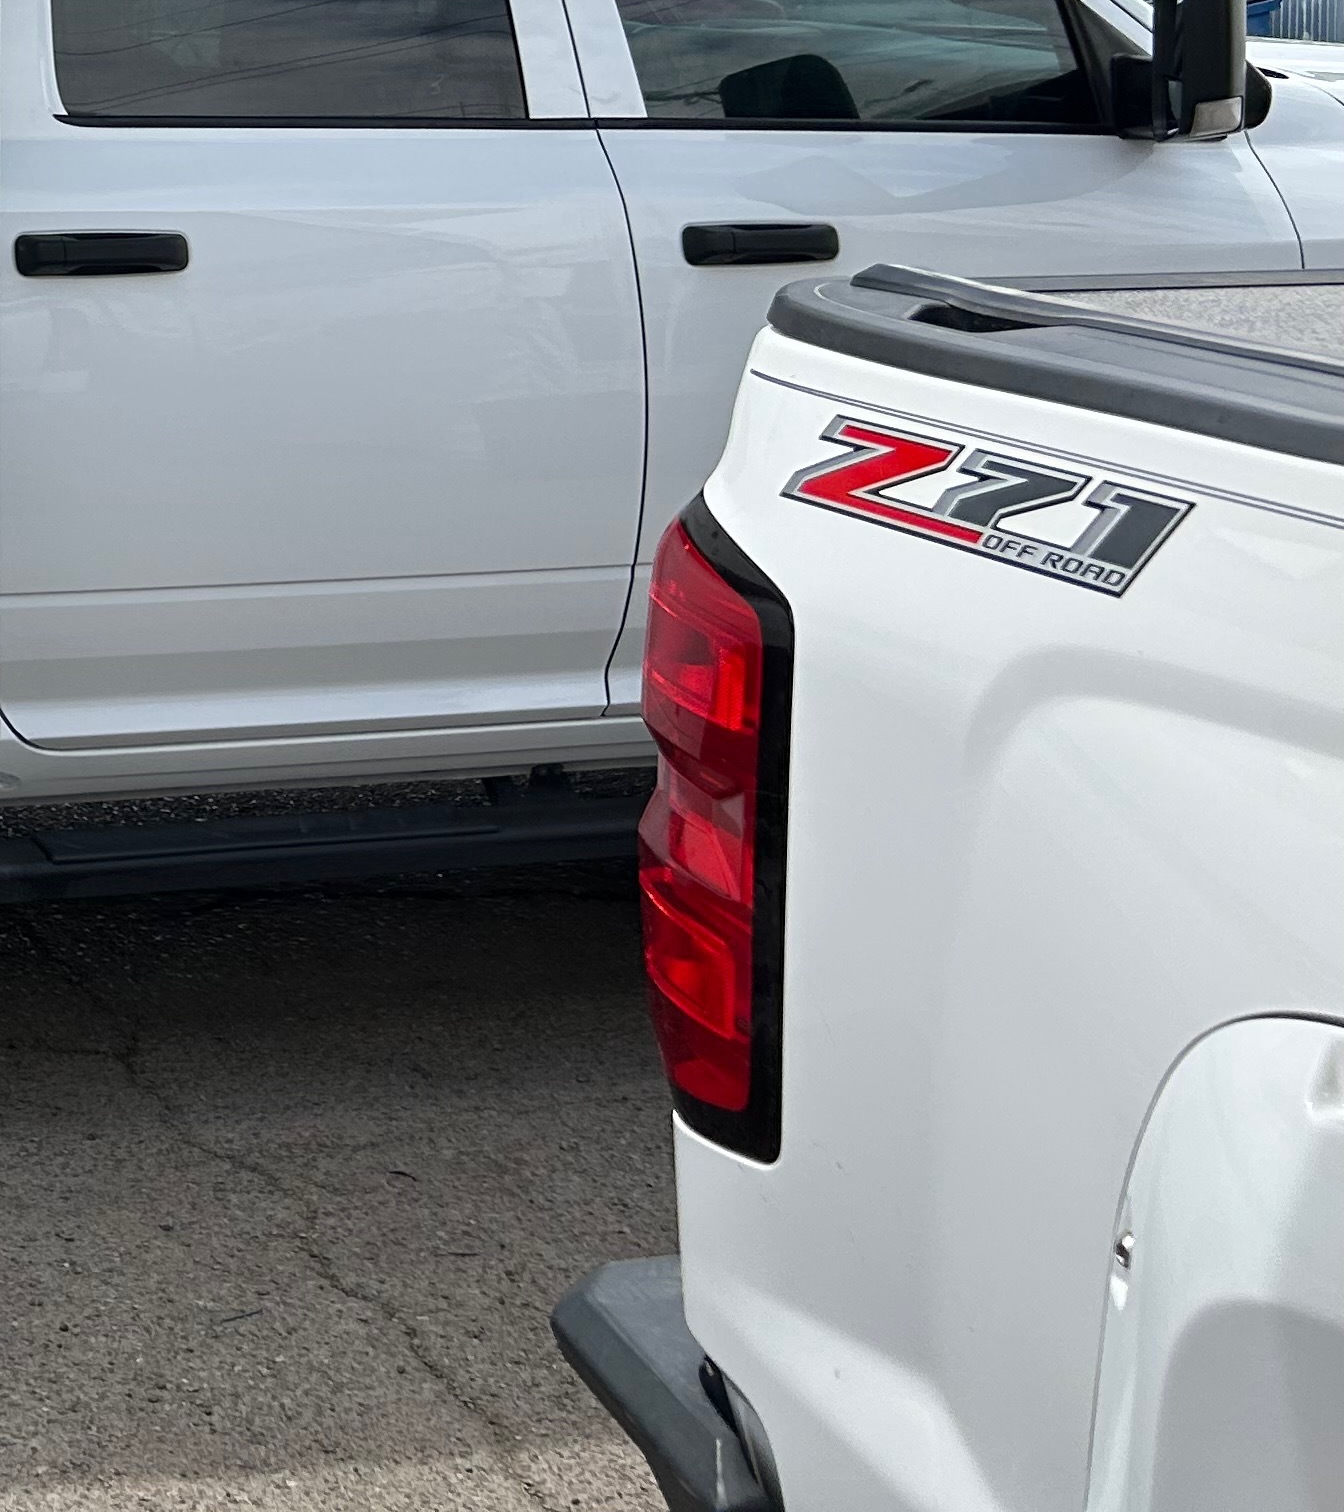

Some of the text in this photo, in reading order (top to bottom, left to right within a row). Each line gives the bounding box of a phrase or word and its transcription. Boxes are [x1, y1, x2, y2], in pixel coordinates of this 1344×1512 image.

[780, 414, 1196, 574] Z71
[981, 534, 1128, 588] OFF ROAD
